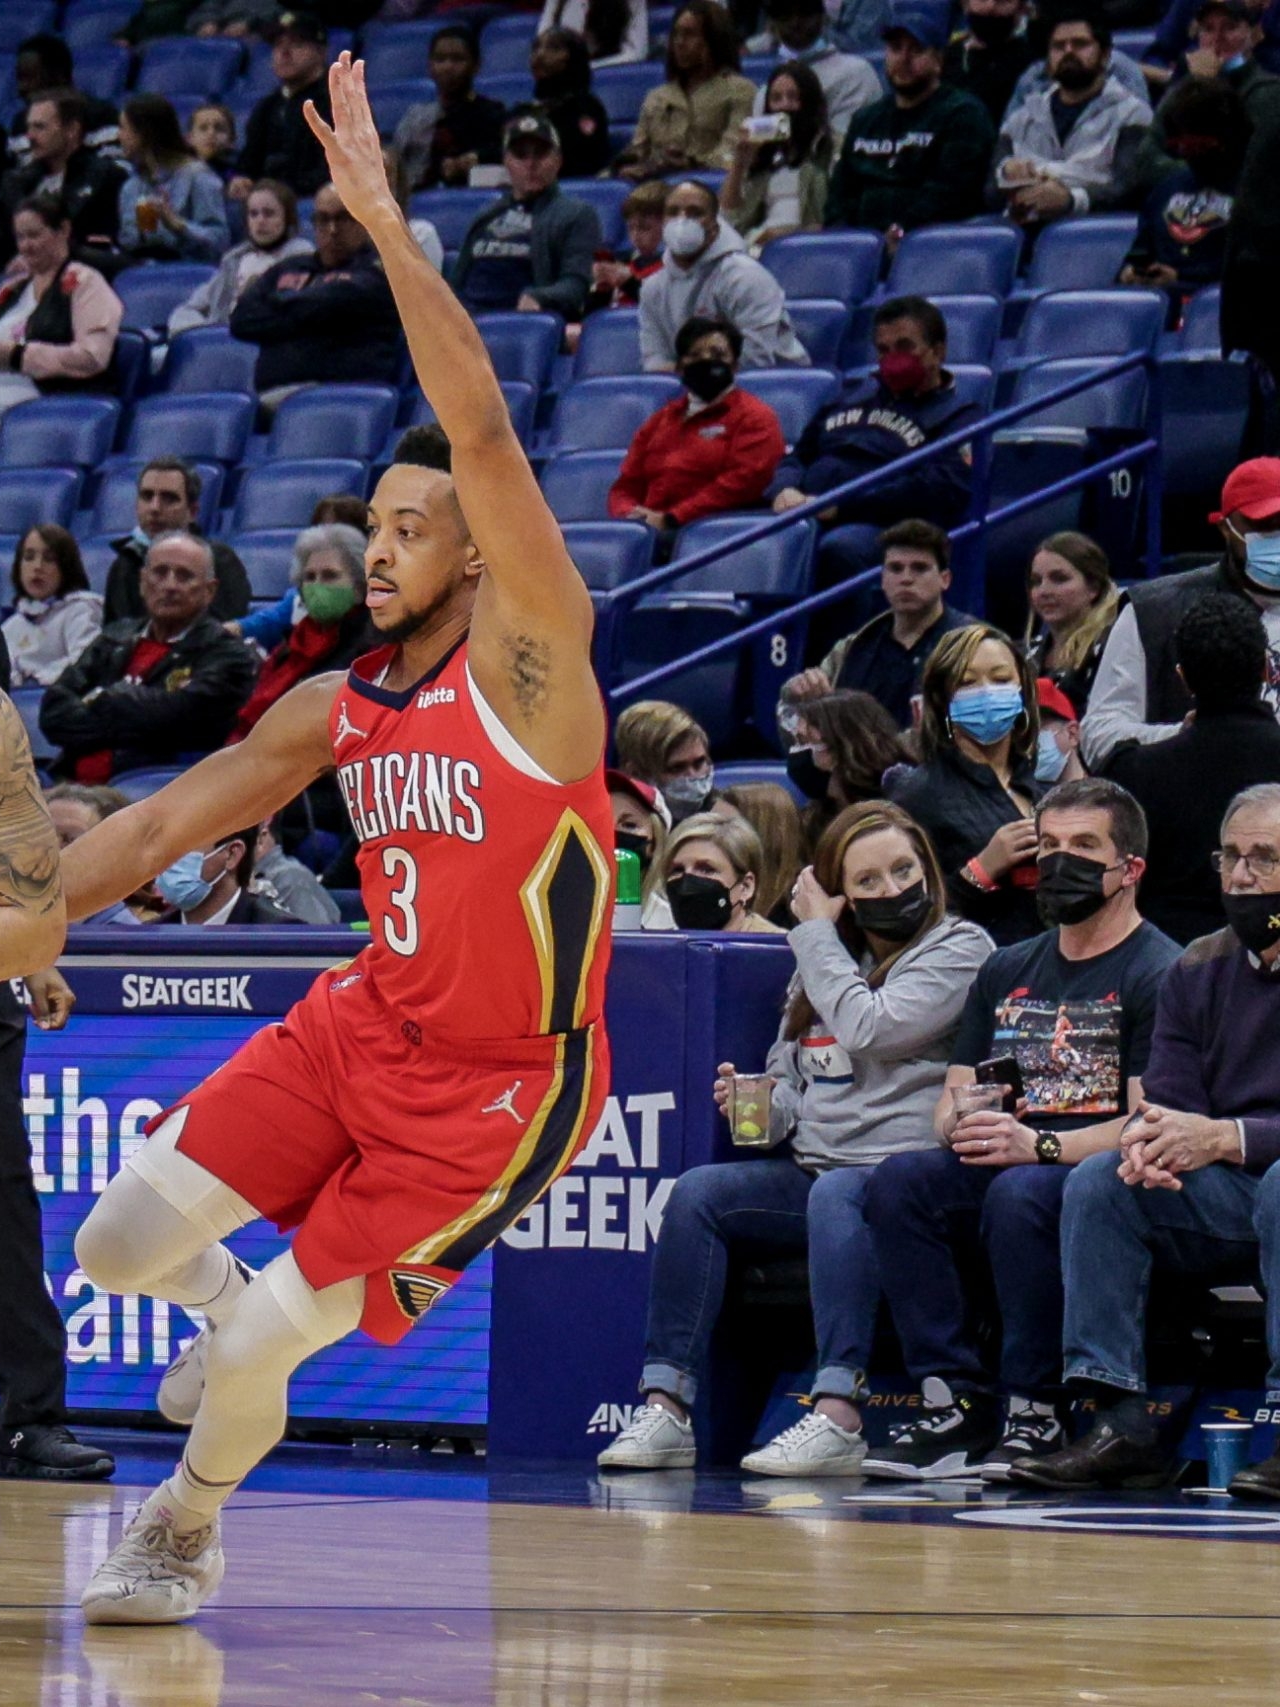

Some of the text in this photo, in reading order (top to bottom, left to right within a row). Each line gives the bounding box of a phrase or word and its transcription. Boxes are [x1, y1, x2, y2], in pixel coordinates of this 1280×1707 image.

[1108, 469, 1131, 498] 10
[770, 634, 787, 667] 8
[337, 751, 485, 844] ELICANS
[381, 846, 418, 957] 3
[122, 973, 253, 1011] SEATGEEK
